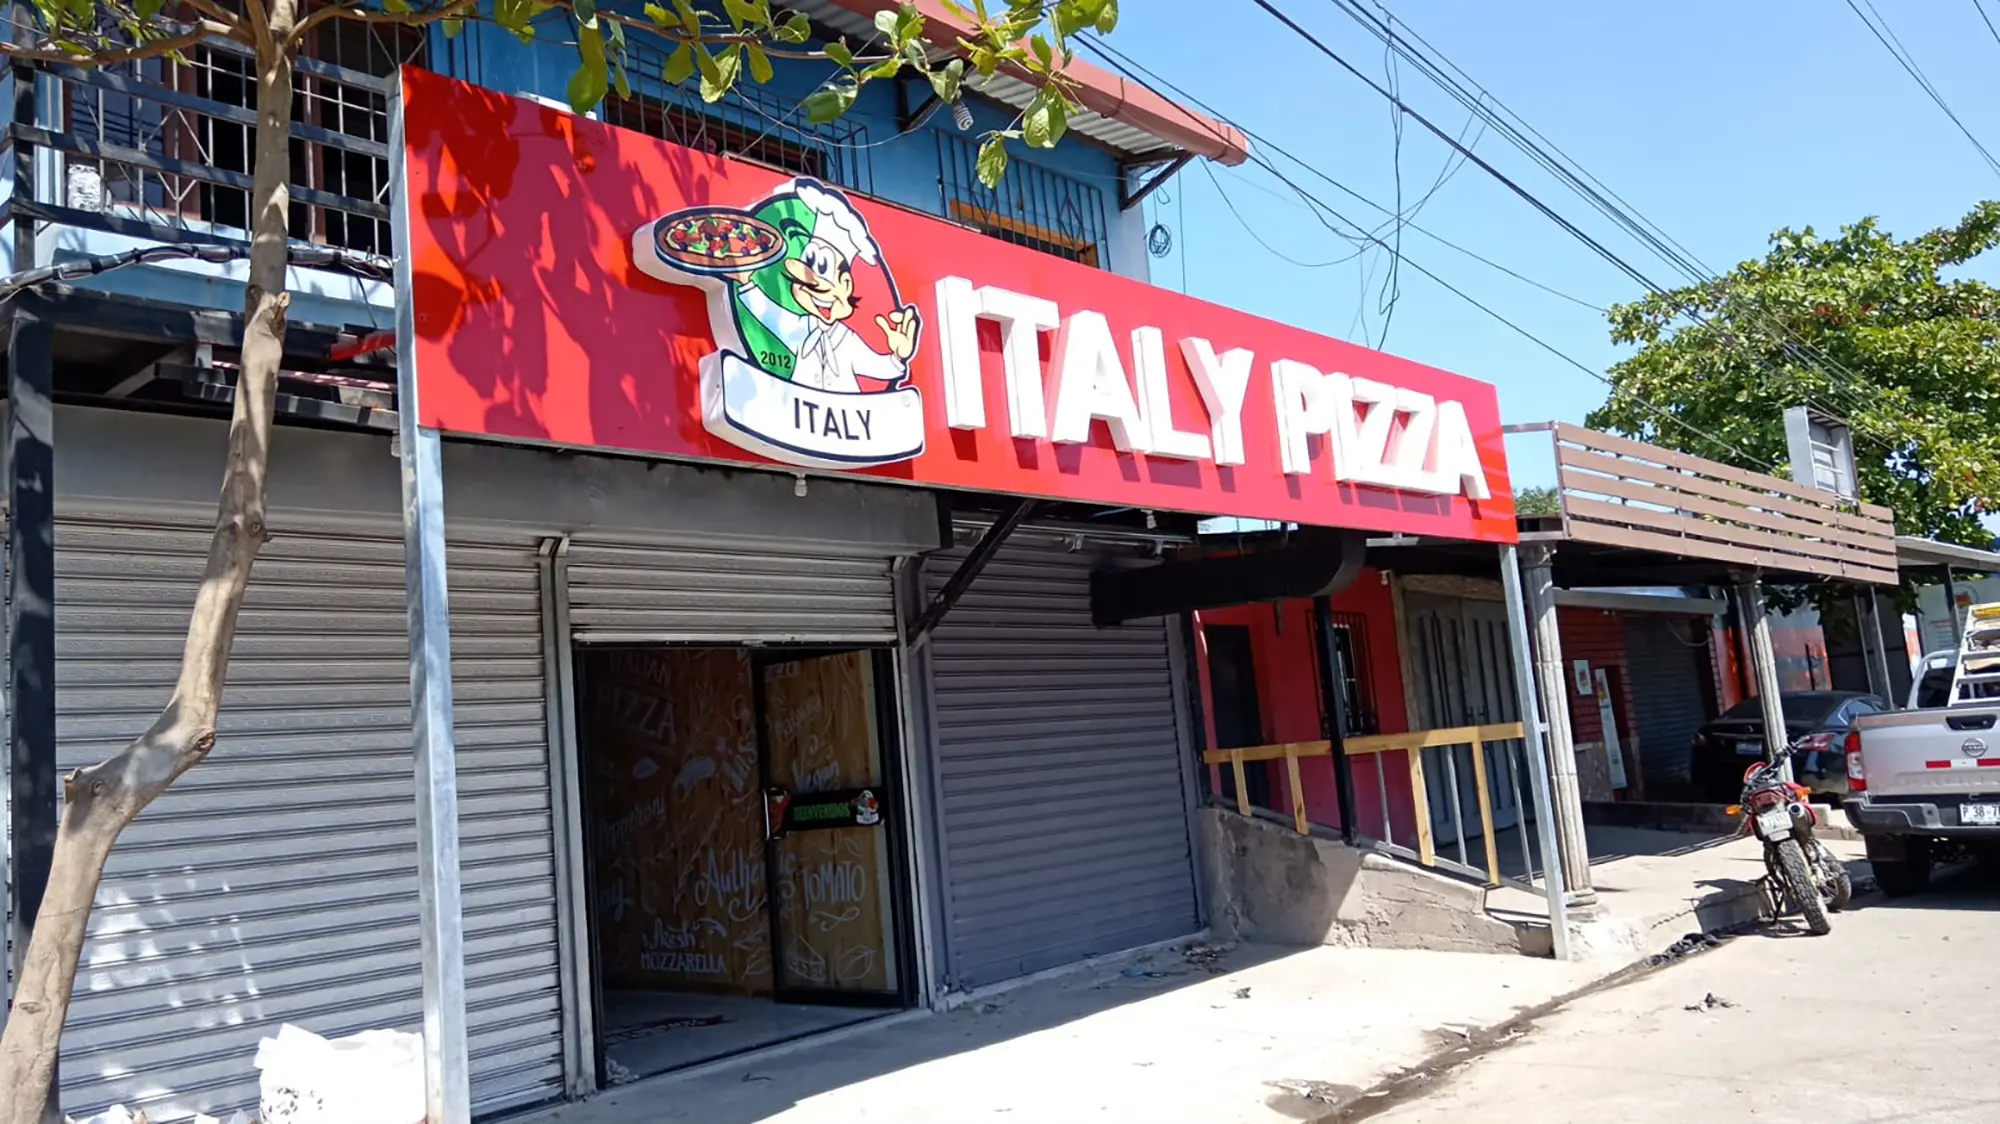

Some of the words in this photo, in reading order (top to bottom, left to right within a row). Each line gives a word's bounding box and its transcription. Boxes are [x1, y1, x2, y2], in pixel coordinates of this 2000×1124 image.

[760, 351, 792, 370] 2012
[935, 275, 1255, 467] ITALY
[1270, 358, 1492, 501] PIZZA
[794, 397, 871, 441] ITALY
[597, 684, 678, 744] PIZZA
[793, 802, 851, 821] BIENVENIDOS
[640, 952, 728, 973] MOZZARELLA
